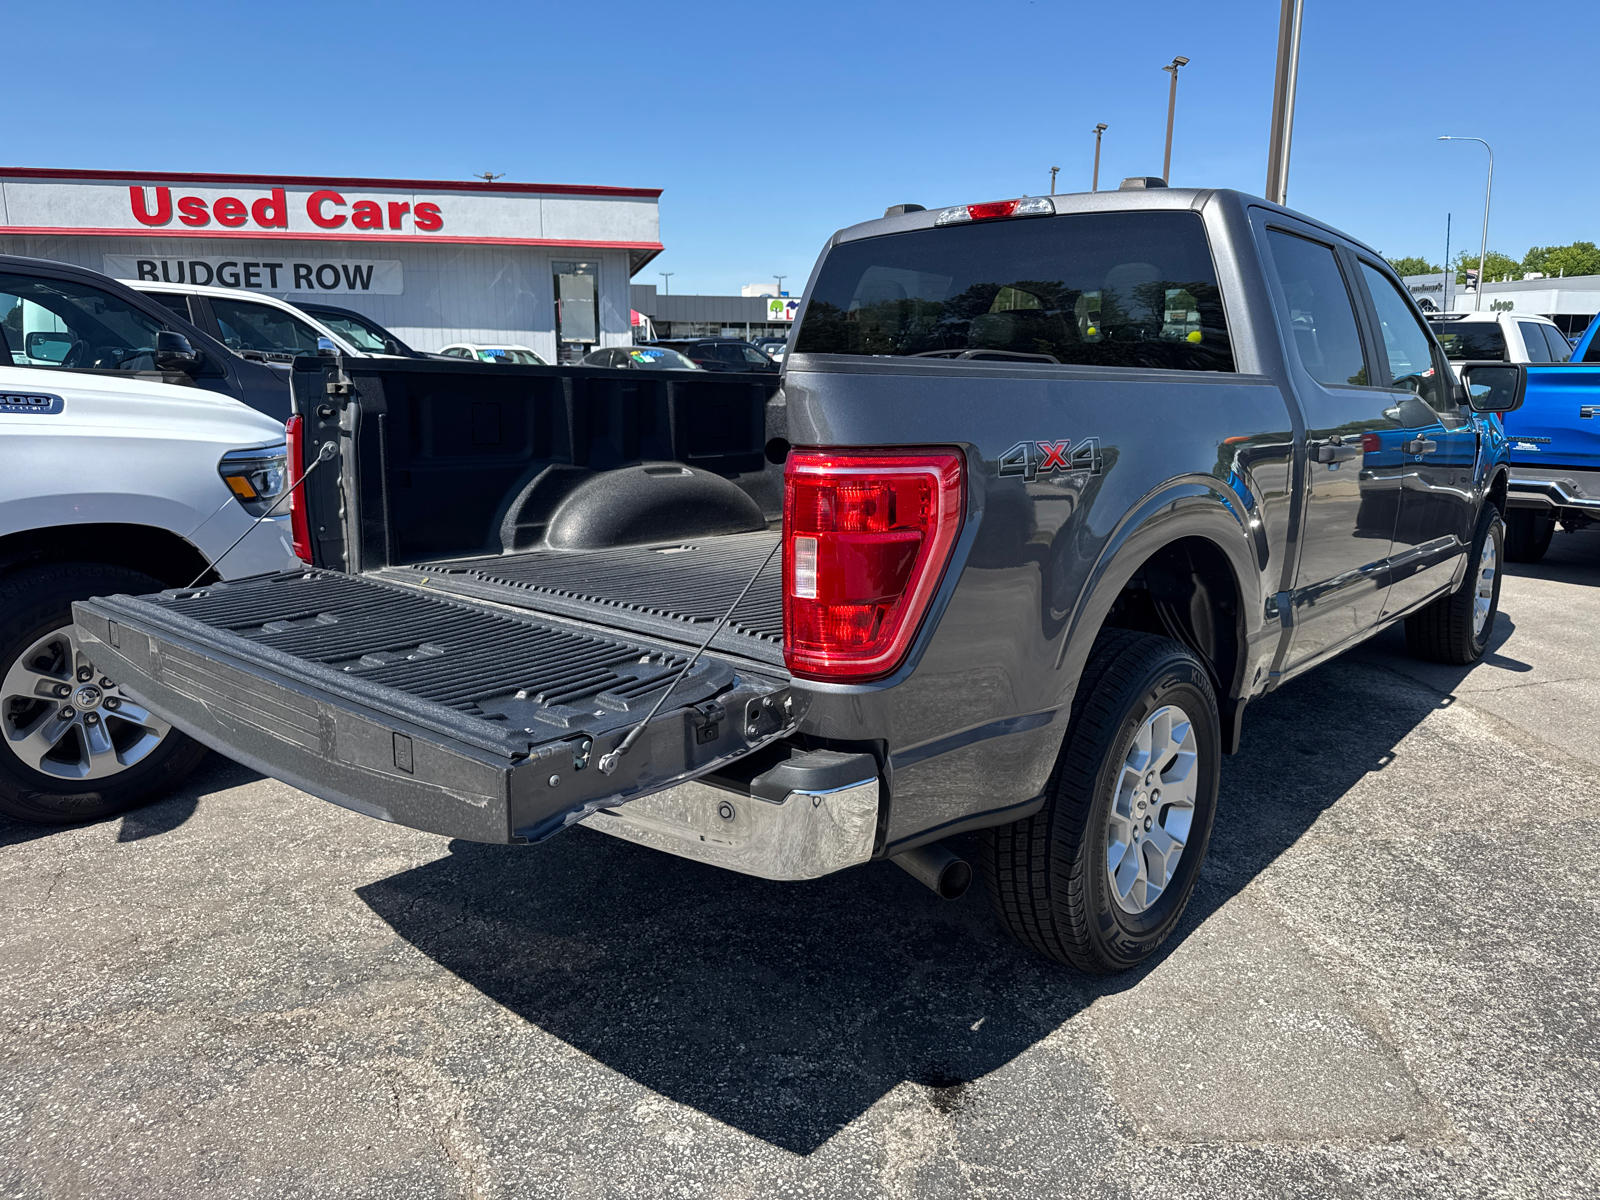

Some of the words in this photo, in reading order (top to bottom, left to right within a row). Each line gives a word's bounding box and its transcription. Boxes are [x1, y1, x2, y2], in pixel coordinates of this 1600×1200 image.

[129, 186, 288, 229] Used
[306, 189, 444, 231] Cars
[136, 260, 283, 289] BUDGET
[294, 264, 374, 291] ROW
[1407, 282, 1443, 294] Landmark
[1490, 299, 1514, 312] Jeep
[1190, 668, 1217, 715] KUMHO
